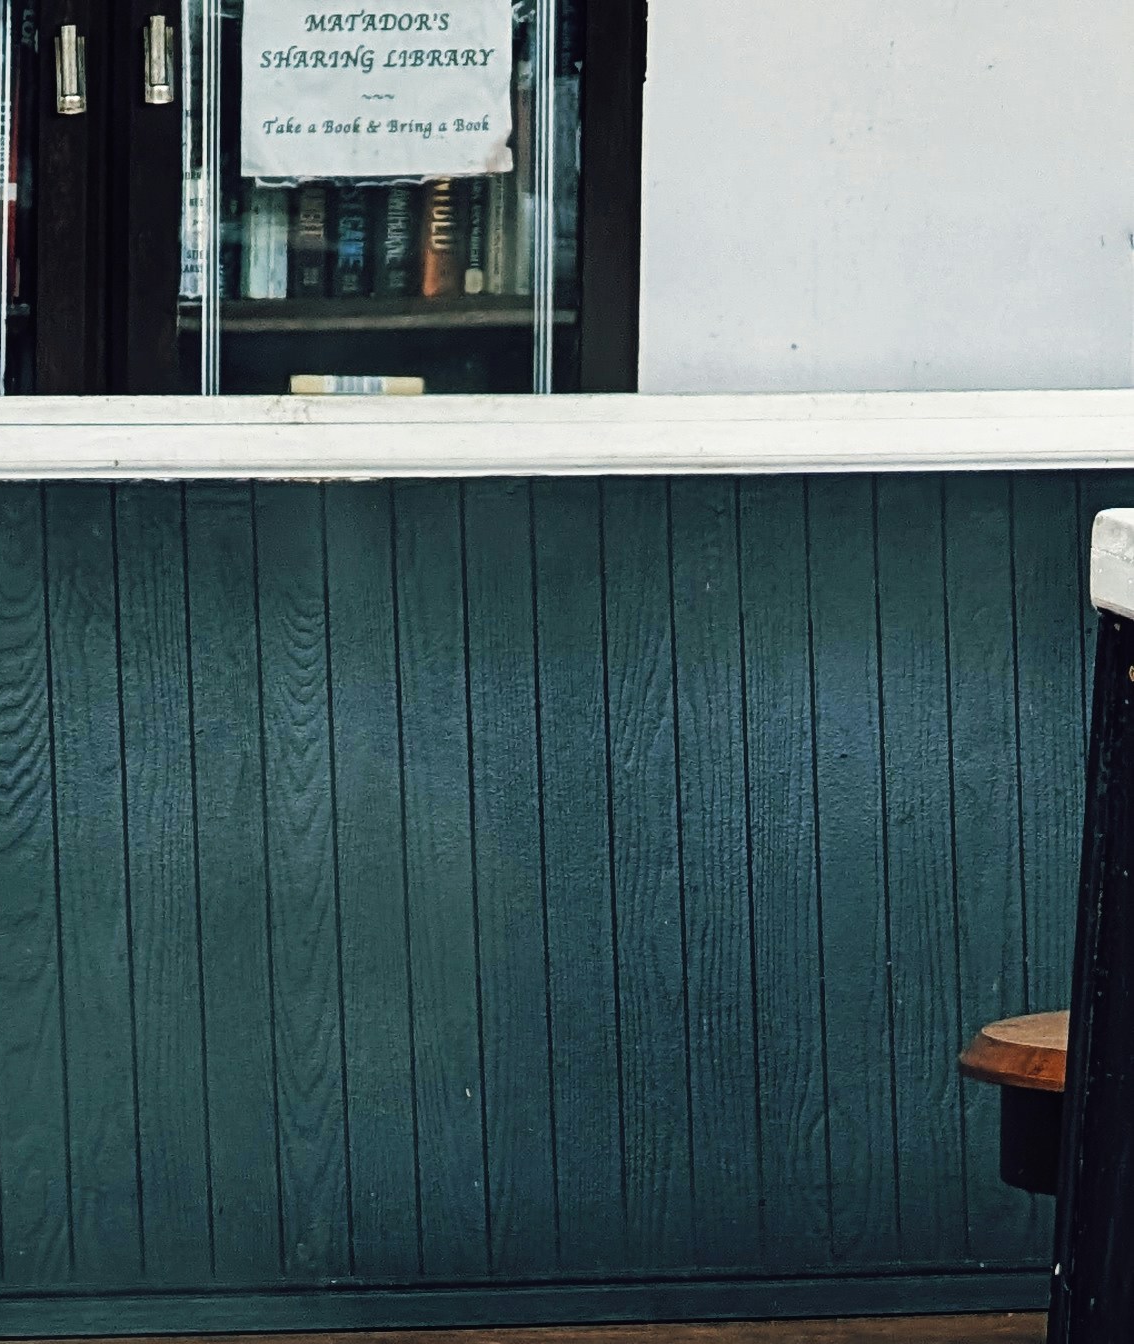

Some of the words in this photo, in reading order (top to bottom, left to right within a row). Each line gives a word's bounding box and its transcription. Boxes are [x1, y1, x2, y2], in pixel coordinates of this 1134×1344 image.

[304, 9, 450, 32] MATADOR'S
[260, 45, 375, 73] SHARING
[383, 48, 495, 68] LIBRARY
[262, 117, 302, 135] Take
[307, 124, 317, 134] a
[322, 117, 362, 134] Book
[366, 121, 382, 134] &
[387, 119, 432, 139] Bring
[438, 122, 447, 132] a
[453, 115, 490, 132] Book
[385, 190, 409, 265] AWTHORNE
